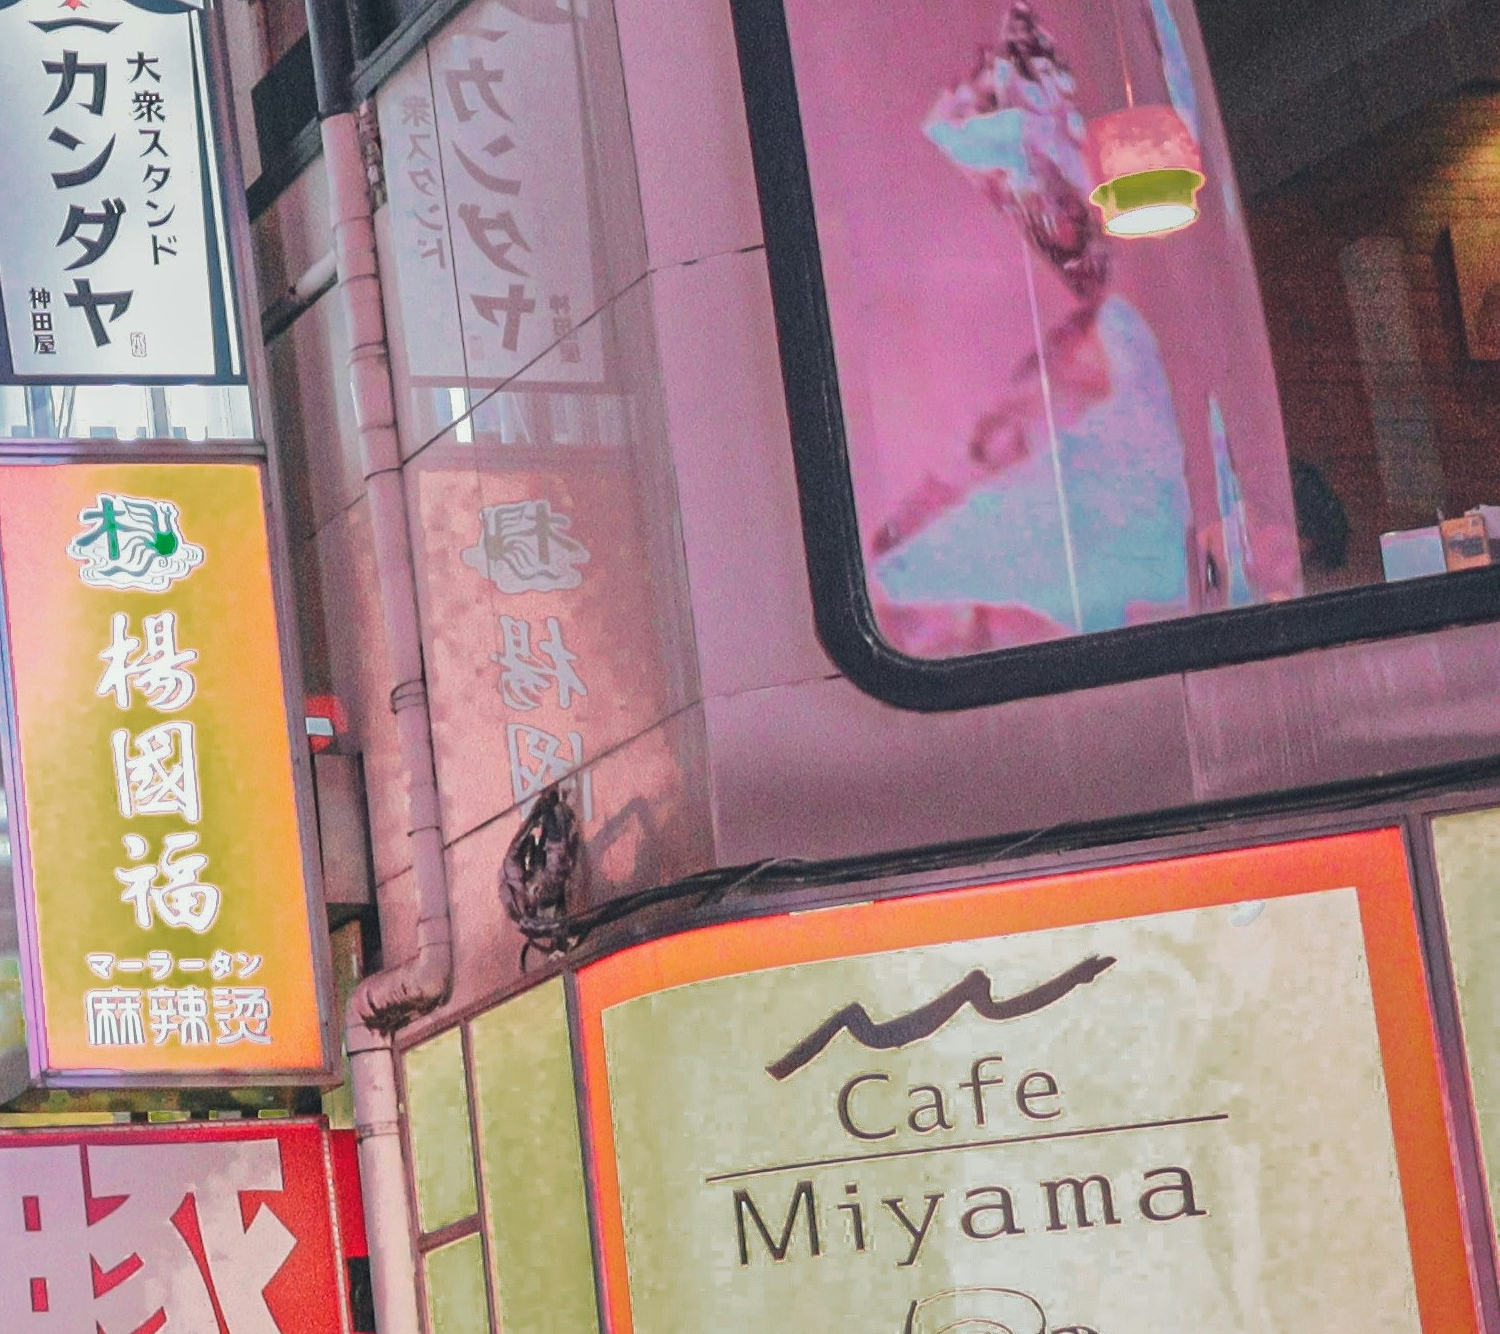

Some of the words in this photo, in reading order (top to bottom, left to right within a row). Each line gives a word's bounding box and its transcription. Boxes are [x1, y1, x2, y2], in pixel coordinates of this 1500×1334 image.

[41, 49, 133, 348] カンダヤ
[126, 51, 179, 267] 大衆スタンド
[28, 287, 57, 355] 神田屋
[86, 950, 263, 979] マーラータン
[835, 1055, 1064, 1140] Cafe
[732, 1164, 1208, 1269] Miyama
